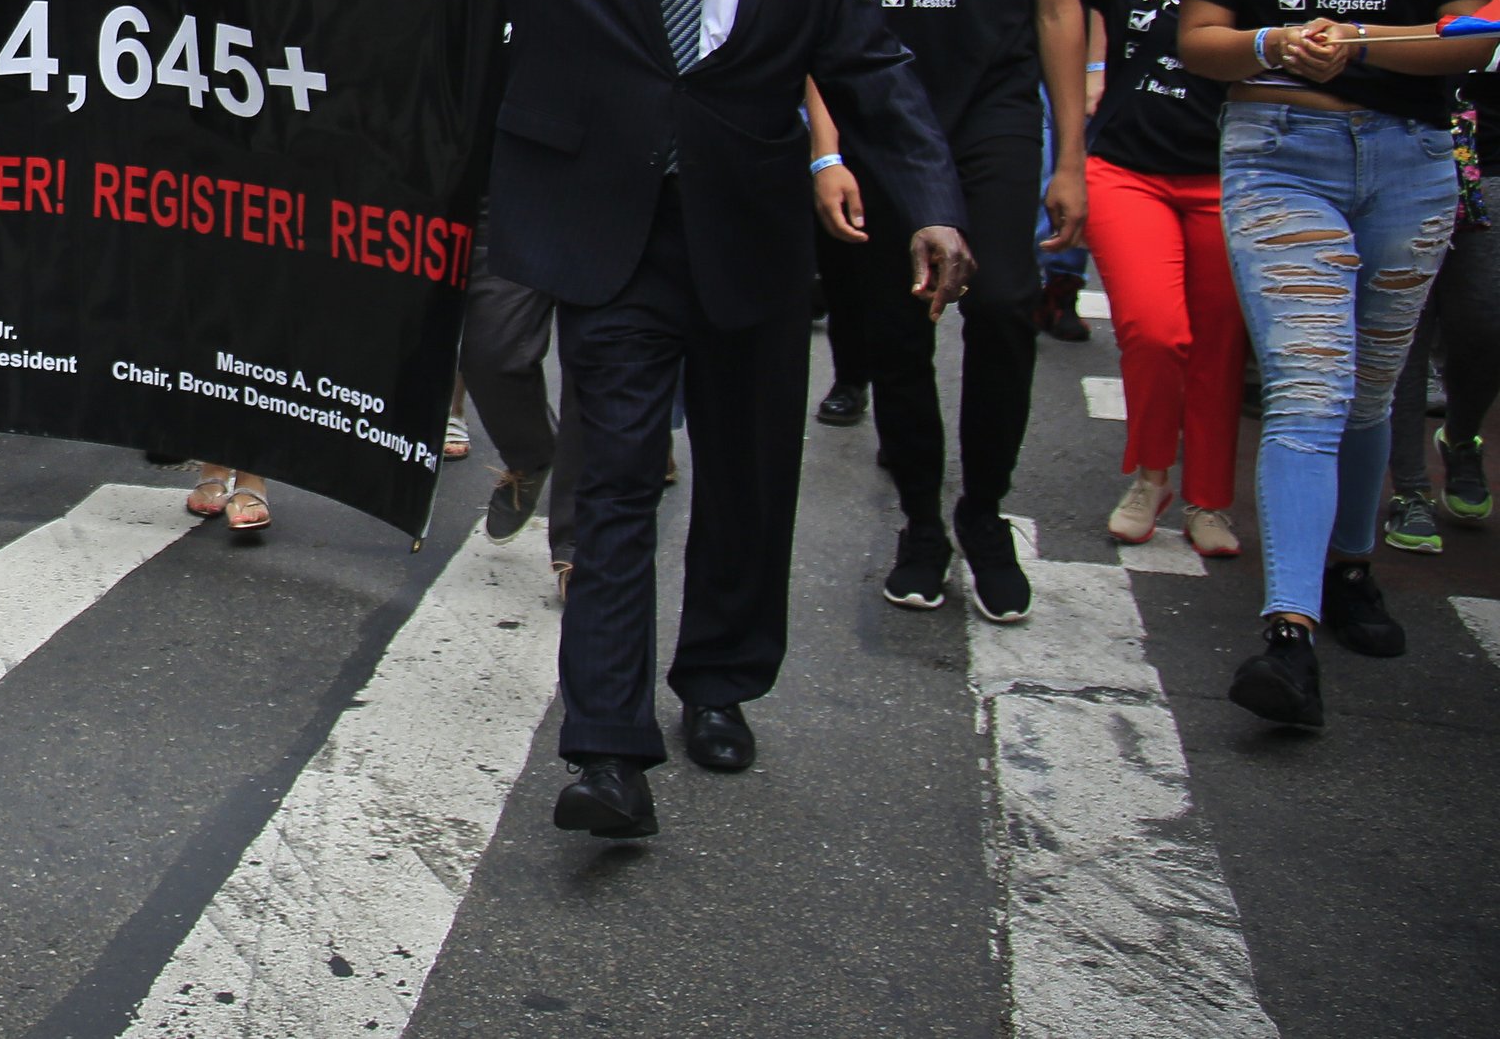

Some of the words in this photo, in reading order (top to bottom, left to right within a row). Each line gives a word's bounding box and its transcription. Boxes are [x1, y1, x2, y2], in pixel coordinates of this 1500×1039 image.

[93, 162, 305, 251] REGISTER!
[331, 199, 473, 291] RESIST!
[112, 361, 173, 392] Chair,
[179, 371, 239, 402] Bronx
[244, 387, 352, 433] Democratic
[355, 418, 414, 462] County
[216, 352, 287, 386] Marcos
[291, 371, 311, 393] A.
[317, 377, 385, 414] Crespo
